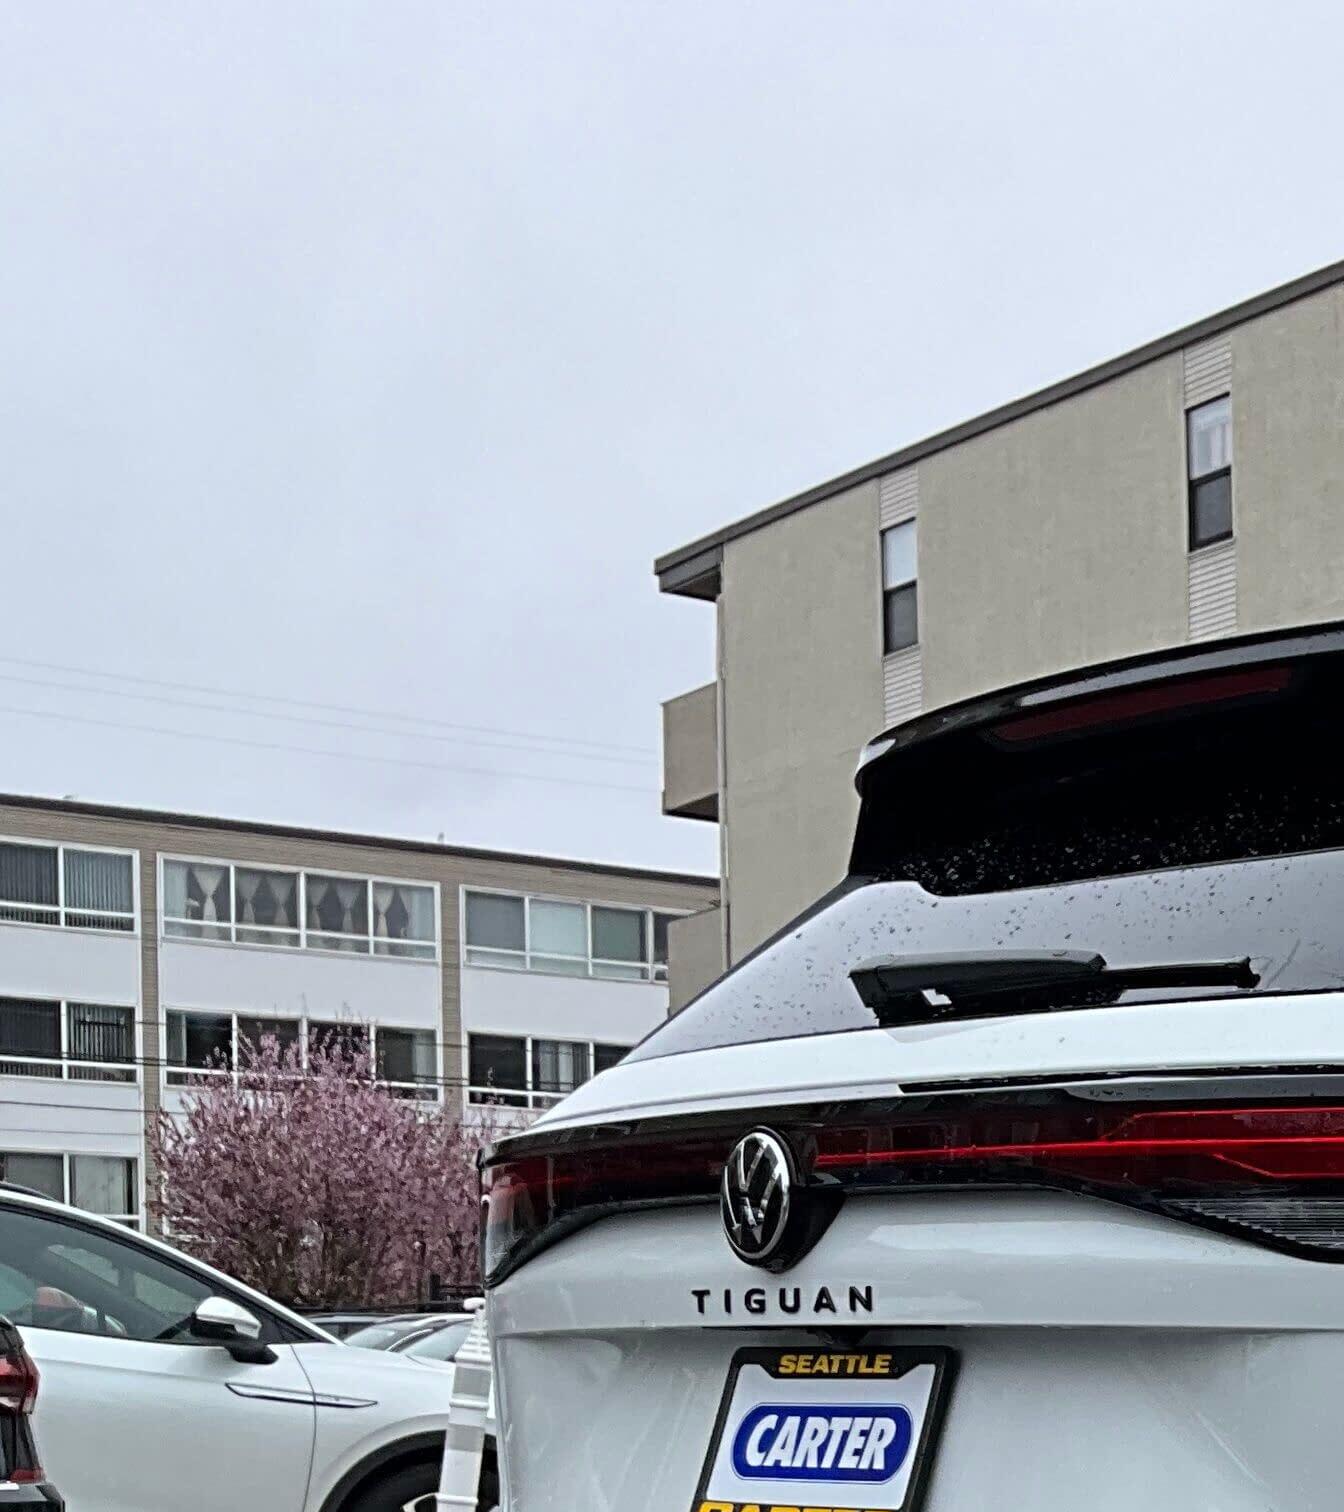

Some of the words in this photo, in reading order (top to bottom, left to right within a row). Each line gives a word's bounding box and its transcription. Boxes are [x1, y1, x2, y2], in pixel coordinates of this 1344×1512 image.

[691, 1285, 873, 1314] TIGUAN
[778, 1354, 892, 1374] SEATTLE
[745, 1414, 897, 1470] CARTER
